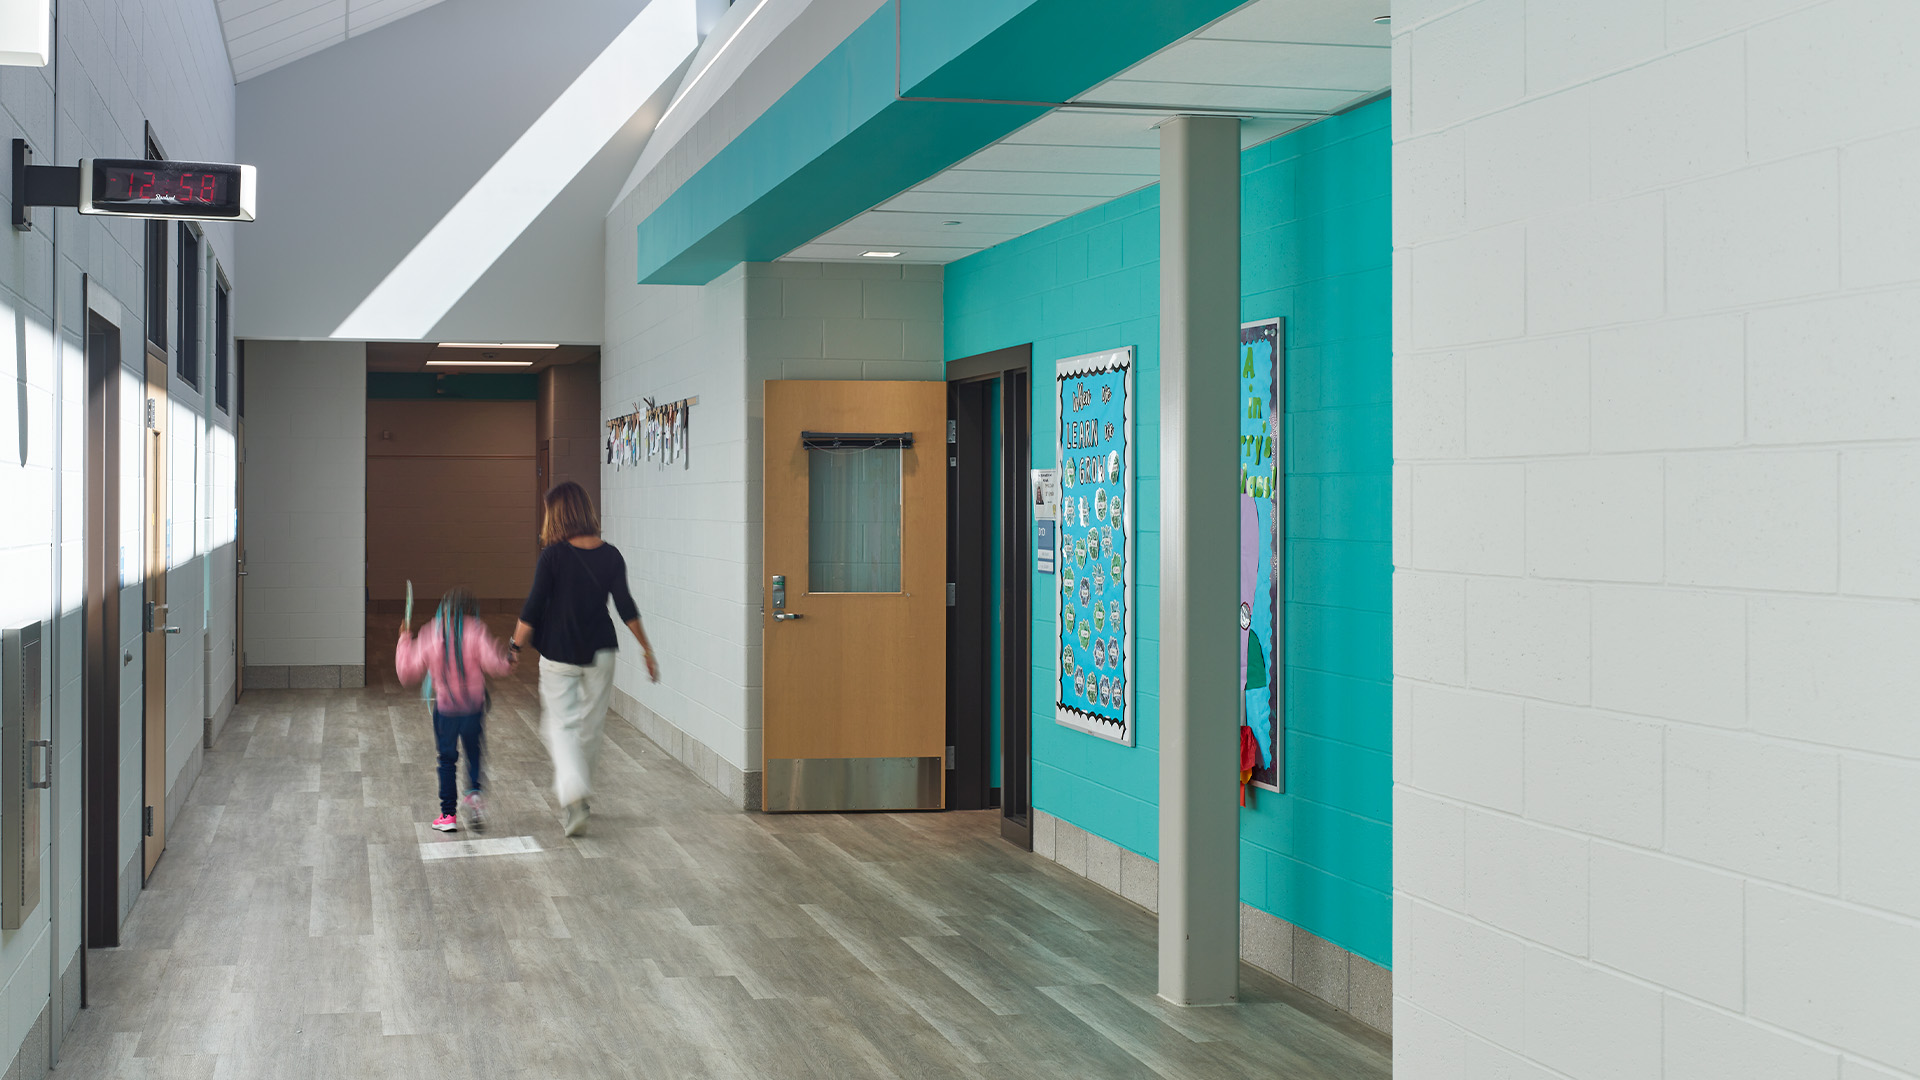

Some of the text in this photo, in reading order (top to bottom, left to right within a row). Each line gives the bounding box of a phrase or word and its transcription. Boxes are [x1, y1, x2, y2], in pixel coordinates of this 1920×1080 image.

[128, 171, 216, 202] 12:58
[1242, 346, 1256, 379] A
[1072, 382, 1092, 413] When
[1248, 383, 1262, 419] in
[1066, 418, 1099, 449] LEARN
[1240, 420, 1272, 465] rry's
[1079, 454, 1106, 485] GROW
[1240, 463, 1277, 500] lass!
